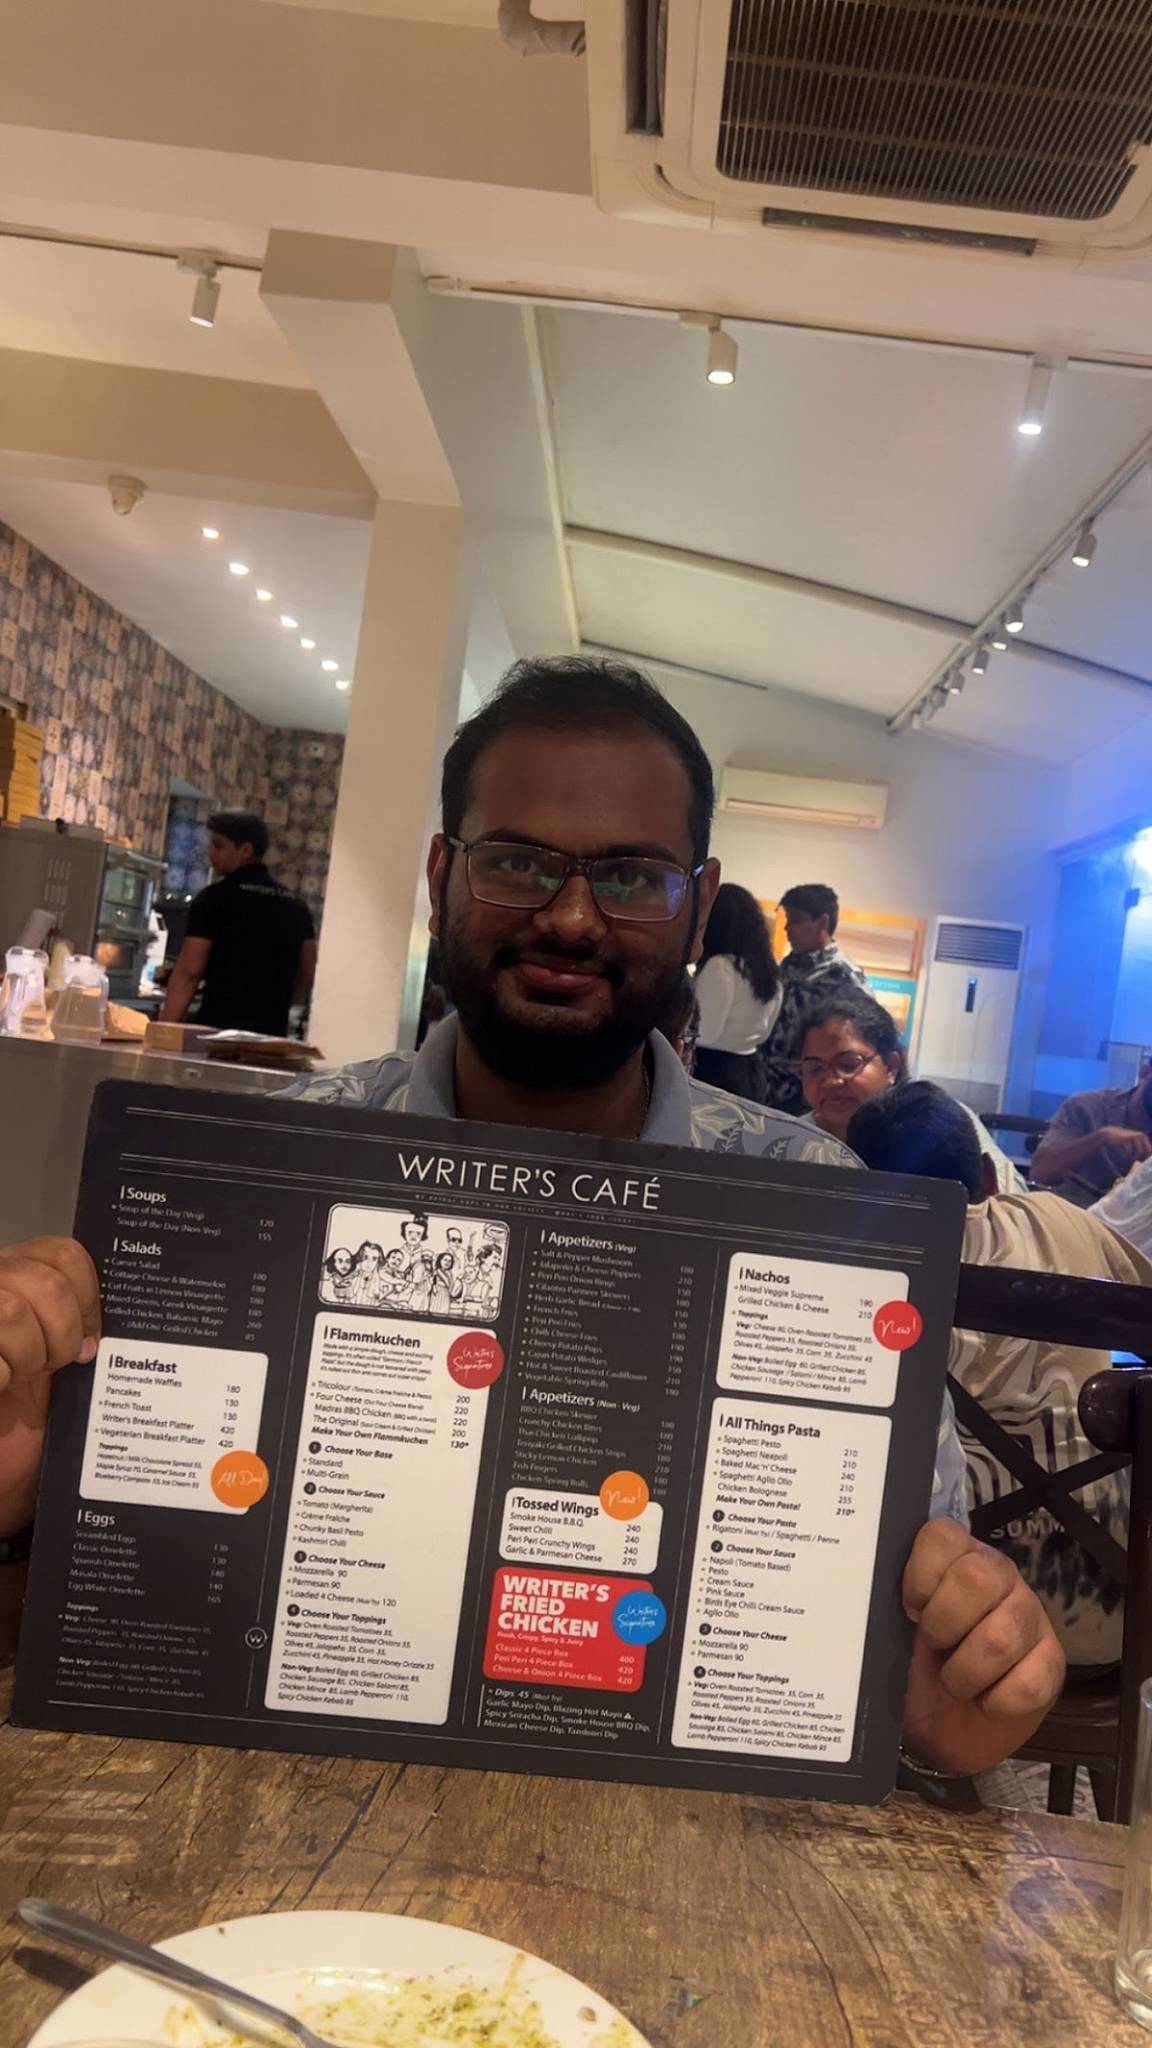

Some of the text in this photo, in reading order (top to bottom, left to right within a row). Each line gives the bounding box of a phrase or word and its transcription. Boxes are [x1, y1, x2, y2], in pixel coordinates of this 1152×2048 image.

[398, 1153, 555, 1197] WRITER'S
[571, 1174, 660, 1209] CAFÉ
[127, 1187, 166, 1204] Soups
[121, 1240, 161, 1255] Salads
[548, 1231, 613, 1249] Appetizers
[745, 1268, 790, 1284] Nachos
[739, 1284, 762, 1294] Mixed
[763, 1287, 789, 1298] Veggie
[791, 1290, 824, 1301] Supreme
[737, 1295, 763, 1306] Grilled
[763, 1298, 793, 1309] Chicken
[802, 1303, 829, 1314] Cheese
[858, 1310, 873, 1319] 210
[329, 1327, 420, 1348] Flammkuchen
[880, 1317, 917, 1338] New!
[114, 1356, 177, 1373] Breakfast
[107, 1373, 153, 1384] Homemade
[154, 1378, 182, 1387] Waffles
[105, 1386, 239, 1407] Pancakes 130
[317, 1380, 470, 1404] Tricolour 200
[529, 1388, 594, 1406] Appetizers
[103, 1400, 237, 1421] French Toast 130
[315, 1392, 469, 1415] Four Cheese 220
[102, 1414, 235, 1434] Writer's Breakfast Platter 420
[314, 1403, 467, 1426] Madras BBQ Chicken 220
[311, 1426, 333, 1435] Make
[335, 1428, 353, 1437] Your
[353, 1430, 372, 1438] Own
[373, 1432, 428, 1444] Flammkuchen
[313, 1414, 466, 1438] The Original 200
[725, 1416, 820, 1438] All Things Pasta
[100, 1427, 233, 1448] Vegetarian Breakfast Platter 420
[723, 1434, 858, 1457] Spaghetti Pesto 210
[308, 1457, 343, 1468] Standard
[324, 1445, 393, 1459] Choose Your Base
[722, 1446, 757, 1458] Spaghetti
[842, 1460, 857, 1469] 210
[307, 1468, 349, 1479] Multi-Grain
[720, 1458, 743, 1468] Baked
[745, 1461, 760, 1470] Mac
[769, 1464, 797, 1474] Cheese
[841, 1472, 855, 1481] 240
[715, 1494, 737, 1503] Make
[739, 1497, 756, 1505] Your
[757, 1499, 775, 1507] Own
[717, 1482, 852, 1504] Chicken Bolognese 255
[515, 1496, 599, 1518] Tossed Wings
[84, 1511, 114, 1527] Eggs
[510, 1511, 536, 1521] Smoke
[537, 1515, 561, 1524] House
[626, 1524, 641, 1533] 240
[508, 1523, 639, 1544] Sweet Chilli 240
[507, 1534, 638, 1555] Peri Peri Crunchy Wings 240
[505, 1545, 527, 1555] Garlic
[536, 1548, 573, 1559] Parmesan
[574, 1552, 602, 1562] Cheese
[622, 1557, 637, 1566] 270
[294, 1565, 347, 1578] Mozzarella 90
[292, 1577, 341, 1589] Parmesan 90
[503, 1575, 609, 1602] WRITER'S
[500, 1593, 565, 1615] FRIED
[498, 1611, 598, 1638] CHICKEN
[494, 1653, 510, 1662] Peri
[511, 1655, 527, 1663] Peri
[535, 1657, 557, 1666] Piece
[618, 1666, 633, 1674] 420
[495, 1643, 522, 1652] Classic
[531, 1646, 552, 1655] Piece
[619, 1656, 635, 1664] 400
[492, 1664, 522, 1673] Cheese
[531, 1667, 556, 1677] Onion
[564, 1671, 585, 1680] Piece
[617, 1676, 632, 1684] 420
